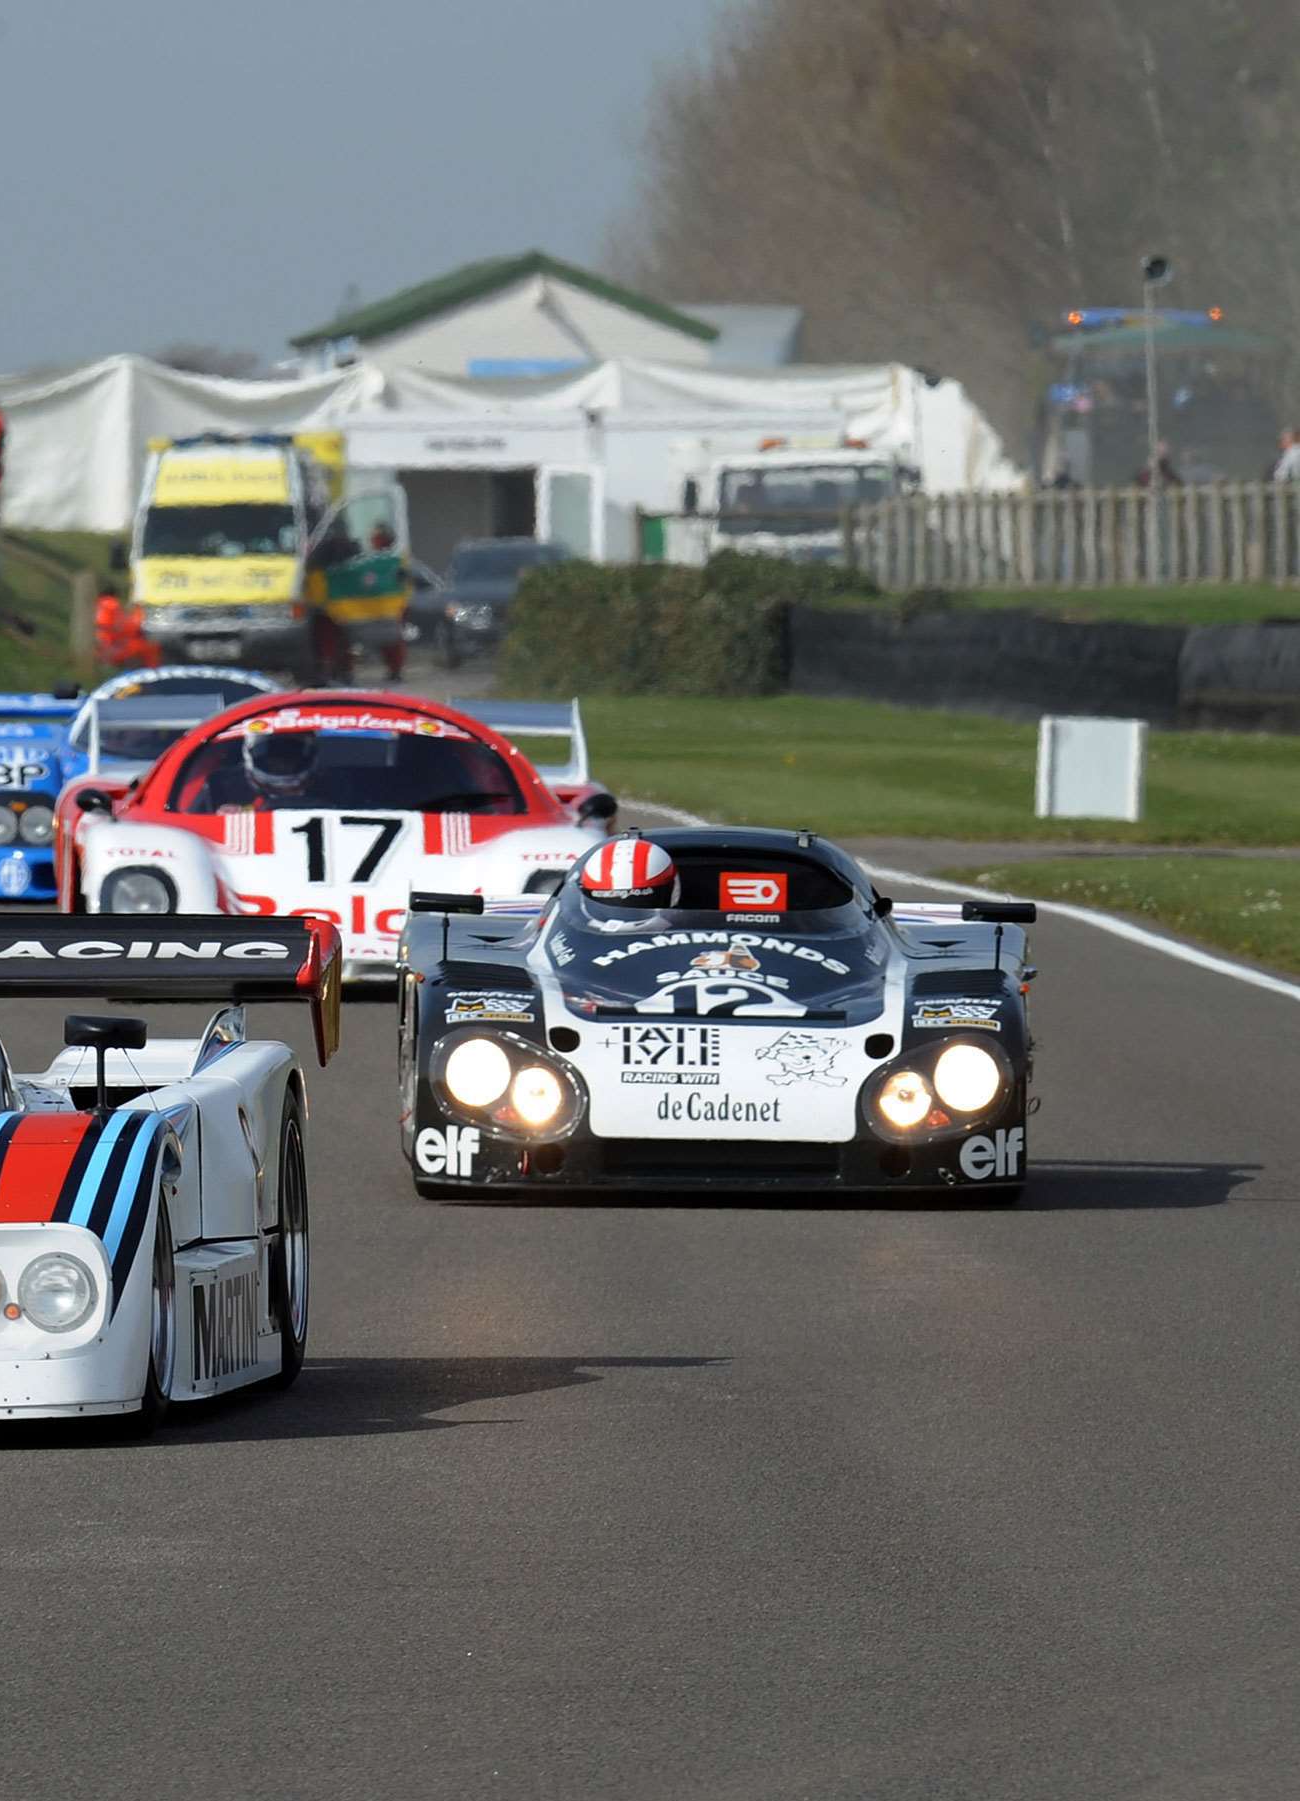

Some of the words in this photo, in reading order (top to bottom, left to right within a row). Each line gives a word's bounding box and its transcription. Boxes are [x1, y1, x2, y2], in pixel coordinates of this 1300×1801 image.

[107, 848, 174, 858] TOTAL
[291, 816, 404, 883] 17
[521, 853, 581, 862] TOTA
[593, 932, 851, 975] HAMMONDS
[656, 969, 791, 990] SAUCE
[611, 1026, 720, 1044] TATE
[622, 1044, 720, 1066] LYLE
[622, 1072, 678, 1084] RACING
[680, 1073, 719, 1085] WITH
[416, 1125, 480, 1177] elf
[959, 1126, 1024, 1180] elf
[193, 1270, 258, 1381] MARTINI
